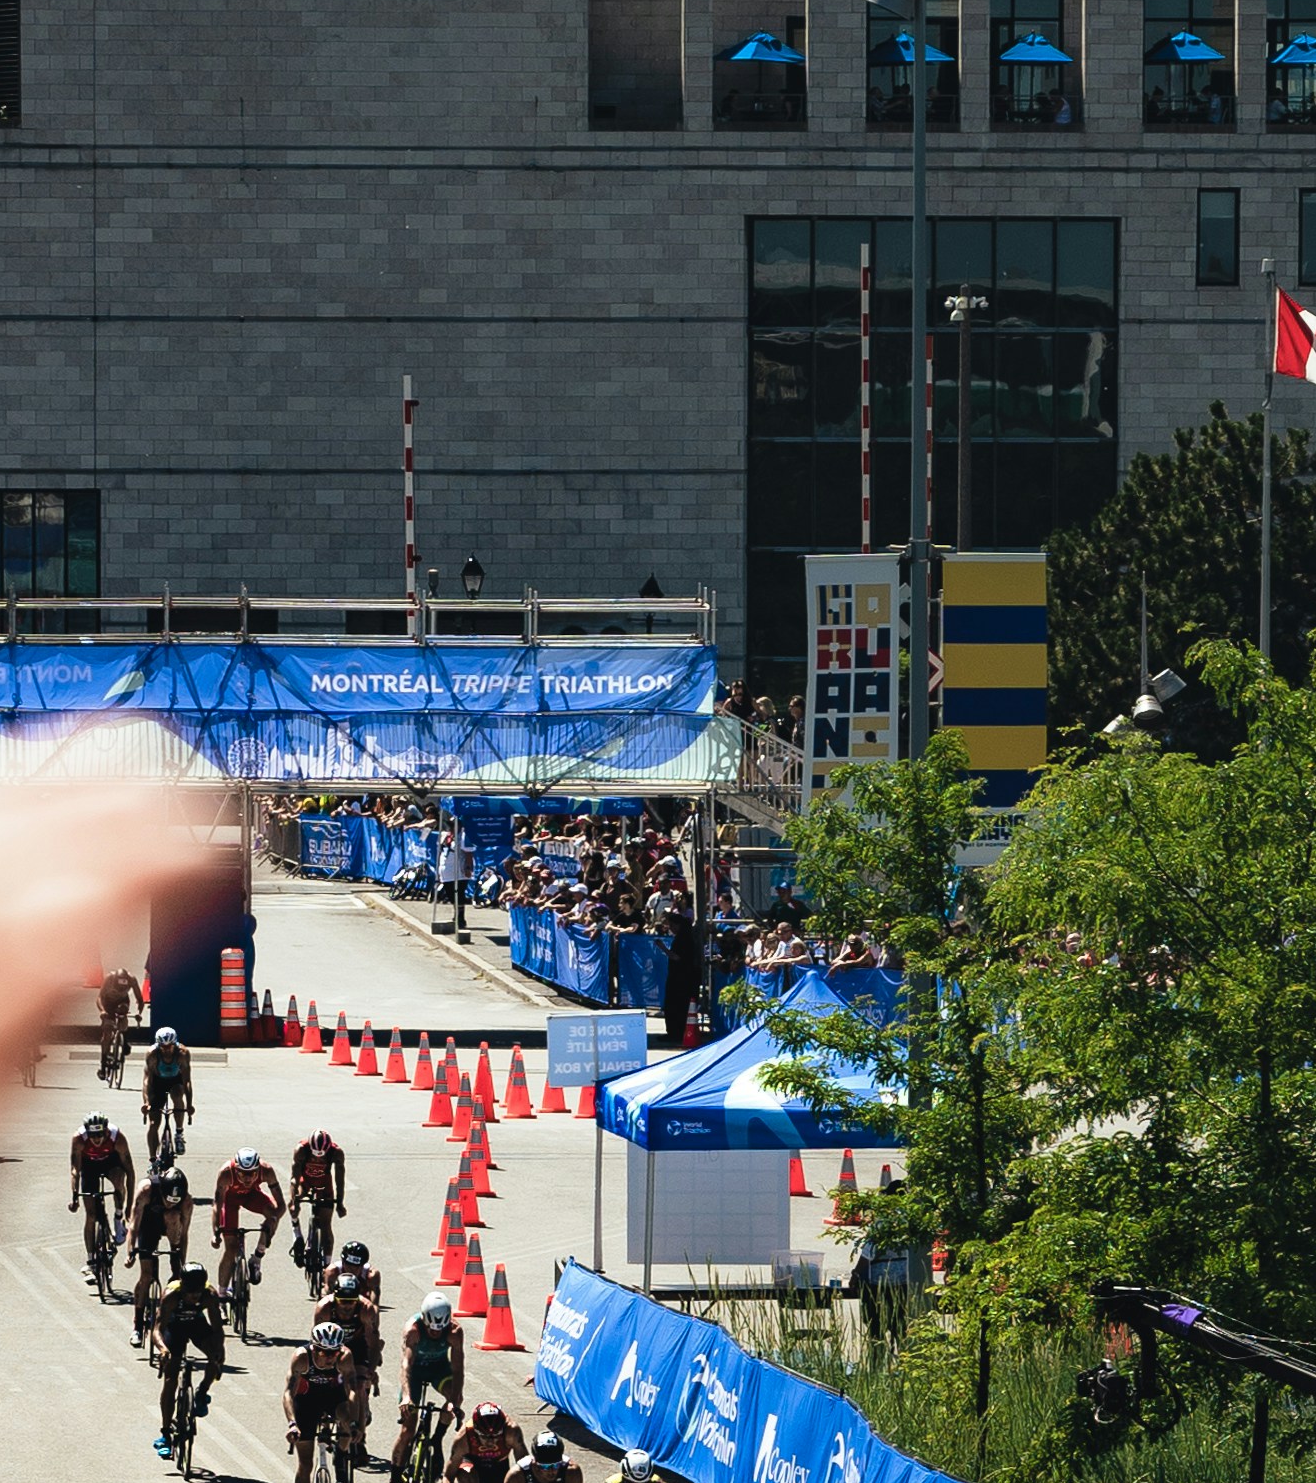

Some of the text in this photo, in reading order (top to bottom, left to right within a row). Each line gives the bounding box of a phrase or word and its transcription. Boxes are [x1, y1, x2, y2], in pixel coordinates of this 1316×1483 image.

[311, 668, 675, 695] MONTRÉAL TRIPPE TRIATHLON
[308, 838, 352, 856] SUBARU
